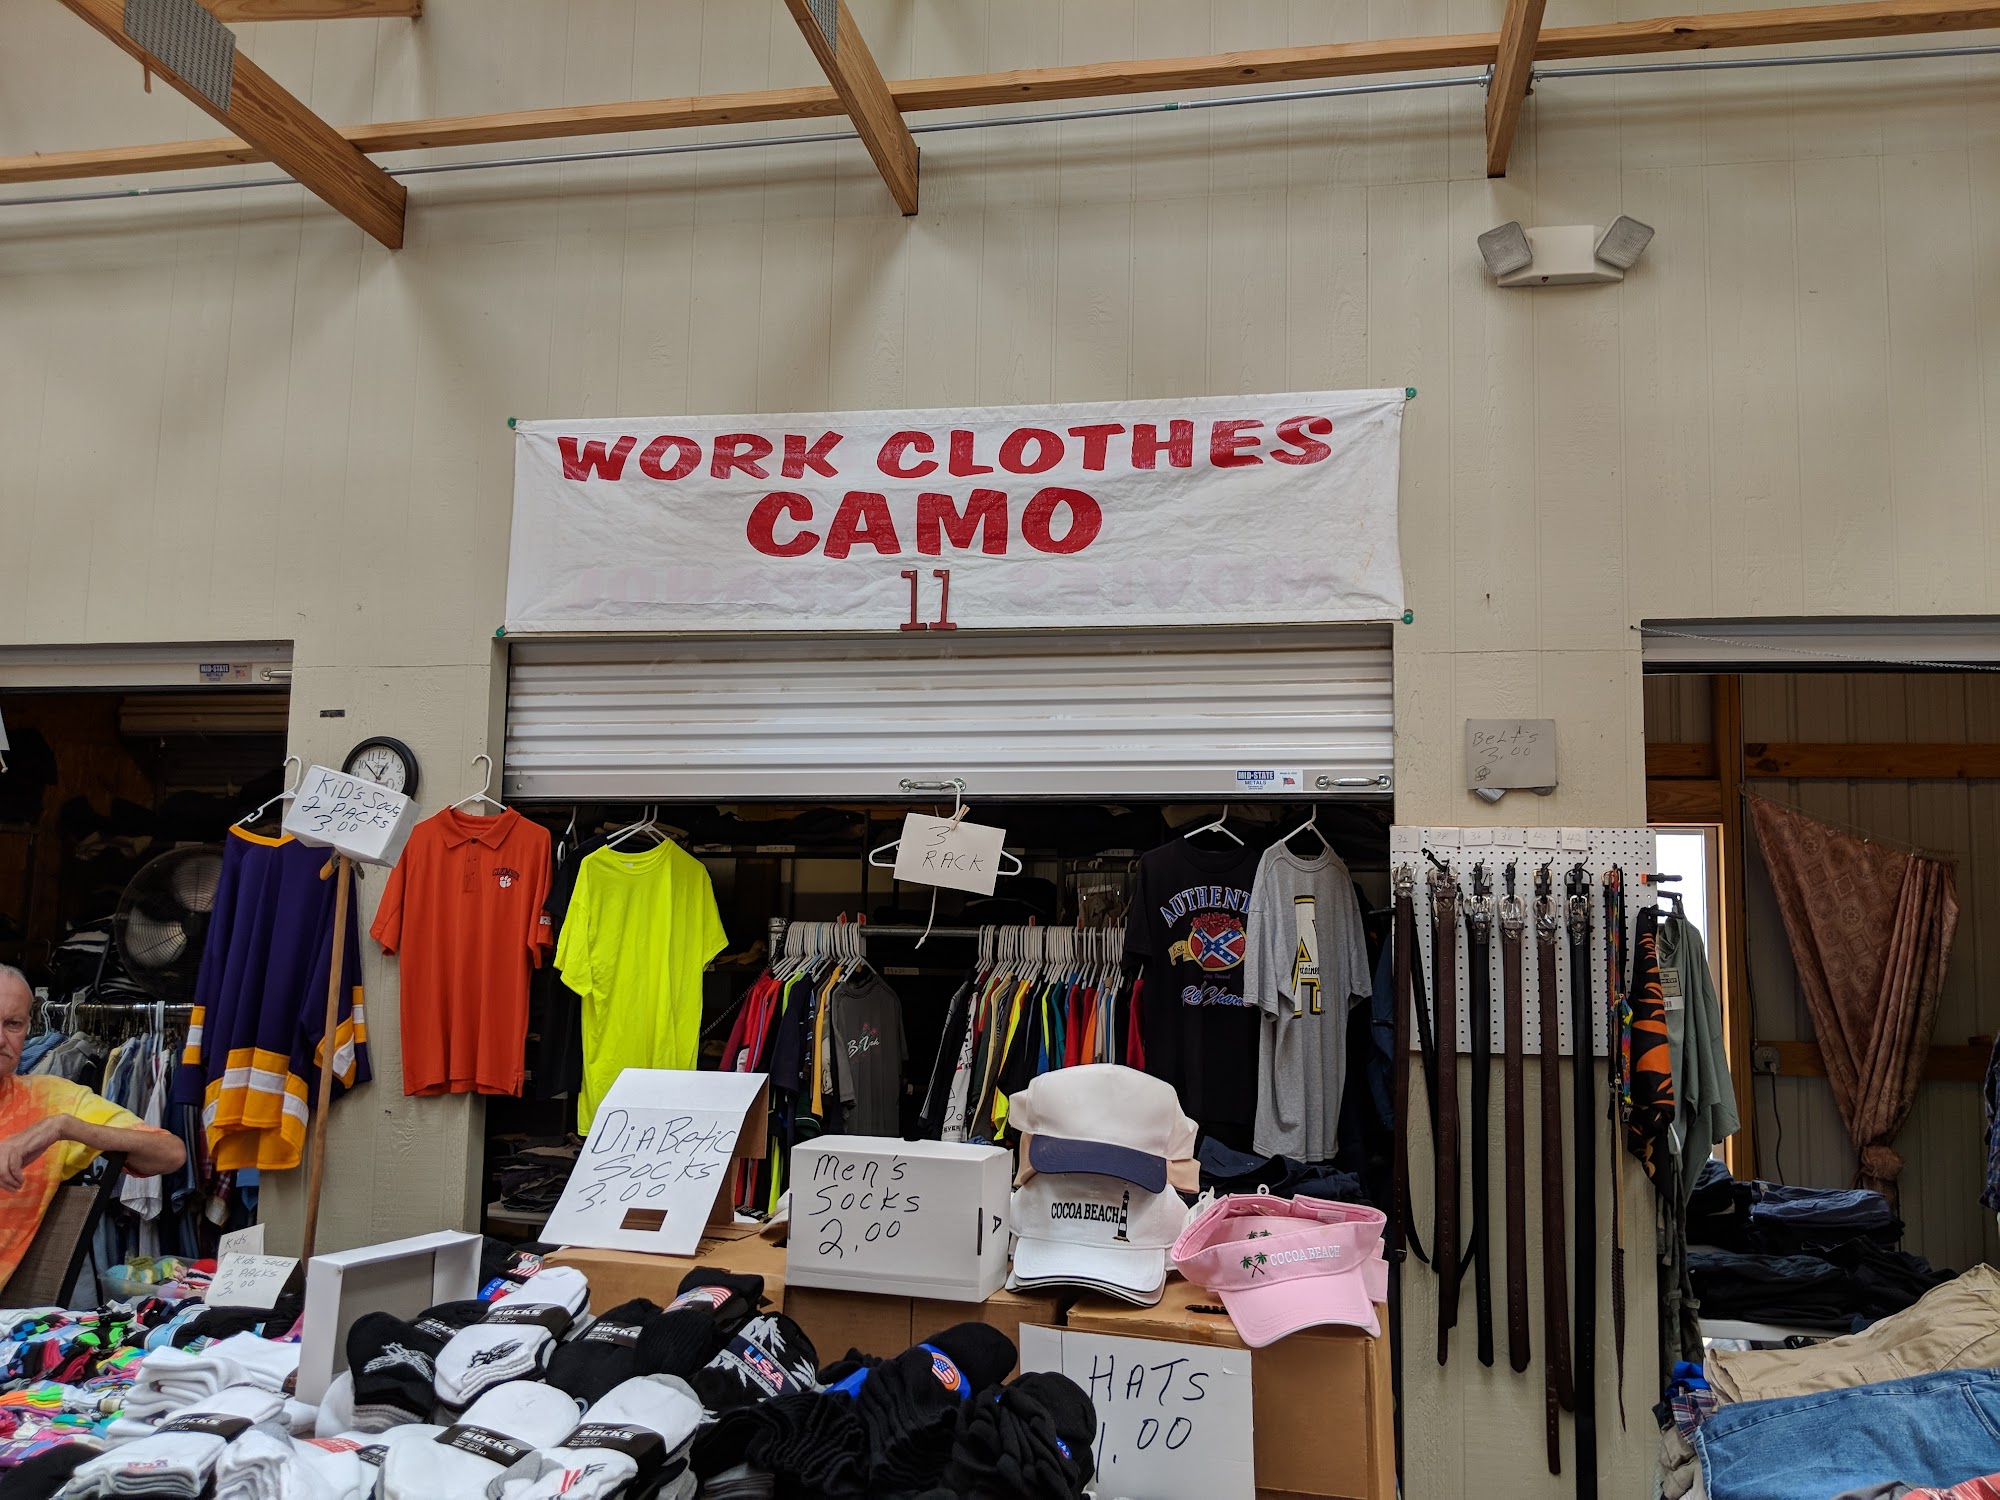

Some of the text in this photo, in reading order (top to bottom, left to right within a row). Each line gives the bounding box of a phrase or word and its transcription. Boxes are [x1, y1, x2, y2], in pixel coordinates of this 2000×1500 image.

[557, 415, 1334, 481] WORK CLOTHES
[746, 486, 1103, 559] CAMO
[899, 569, 957, 631] 11
[302, 796, 389, 829] 2 PACKS
[926, 826, 950, 846] 3
[1397, 834, 1408, 844] 32
[1501, 831, 1512, 841] 38
[1566, 833, 1582, 843] 42
[922, 850, 984, 872] RACK
[1050, 1202, 1120, 1224] COCOA BEACH
[1269, 1245, 1342, 1266] COCOA BEACH
[222, 1269, 234, 1279] 2
[423, 1319, 458, 1335] SOCK
[743, 1345, 784, 1391] USA
[1088, 1354, 1210, 1406] HATS
[460, 1430, 519, 1455] SOCKS
[578, 1429, 636, 1440] SOCKS
[1095, 1416, 1192, 1483] 1.00
